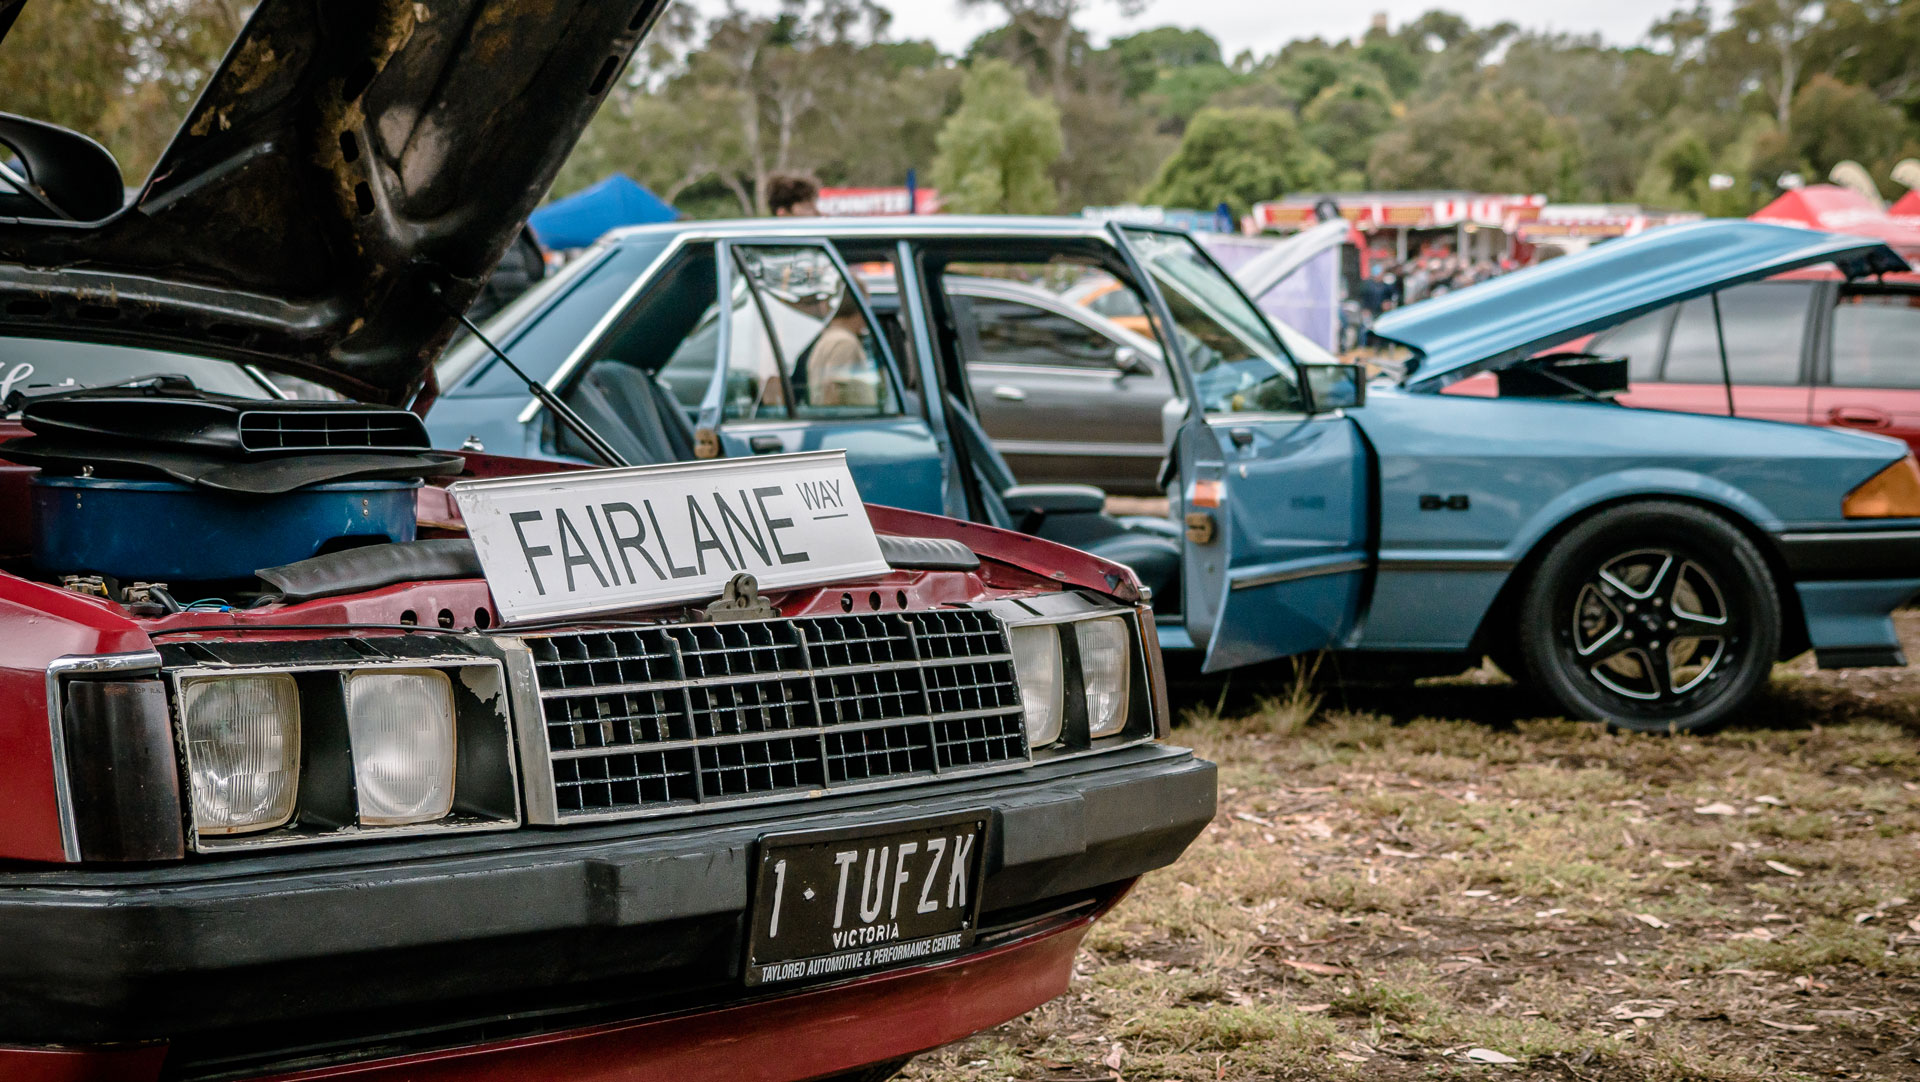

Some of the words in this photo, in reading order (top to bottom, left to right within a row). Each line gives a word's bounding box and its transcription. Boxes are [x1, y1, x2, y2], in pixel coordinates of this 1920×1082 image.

[510, 486, 809, 595] FAIRLANE
[796, 479, 843, 510] WAY
[770, 859, 786, 938] 1
[833, 834, 974, 928] TUFZK
[762, 962, 806, 983] TAYLORED
[807, 952, 863, 976] AUTOMOTIVE
[864, 950, 872, 967] &
[873, 939, 931, 965] PERFORMANCE
[932, 933, 962, 953] CENTRE
[833, 922, 899, 949] VICTORIA
